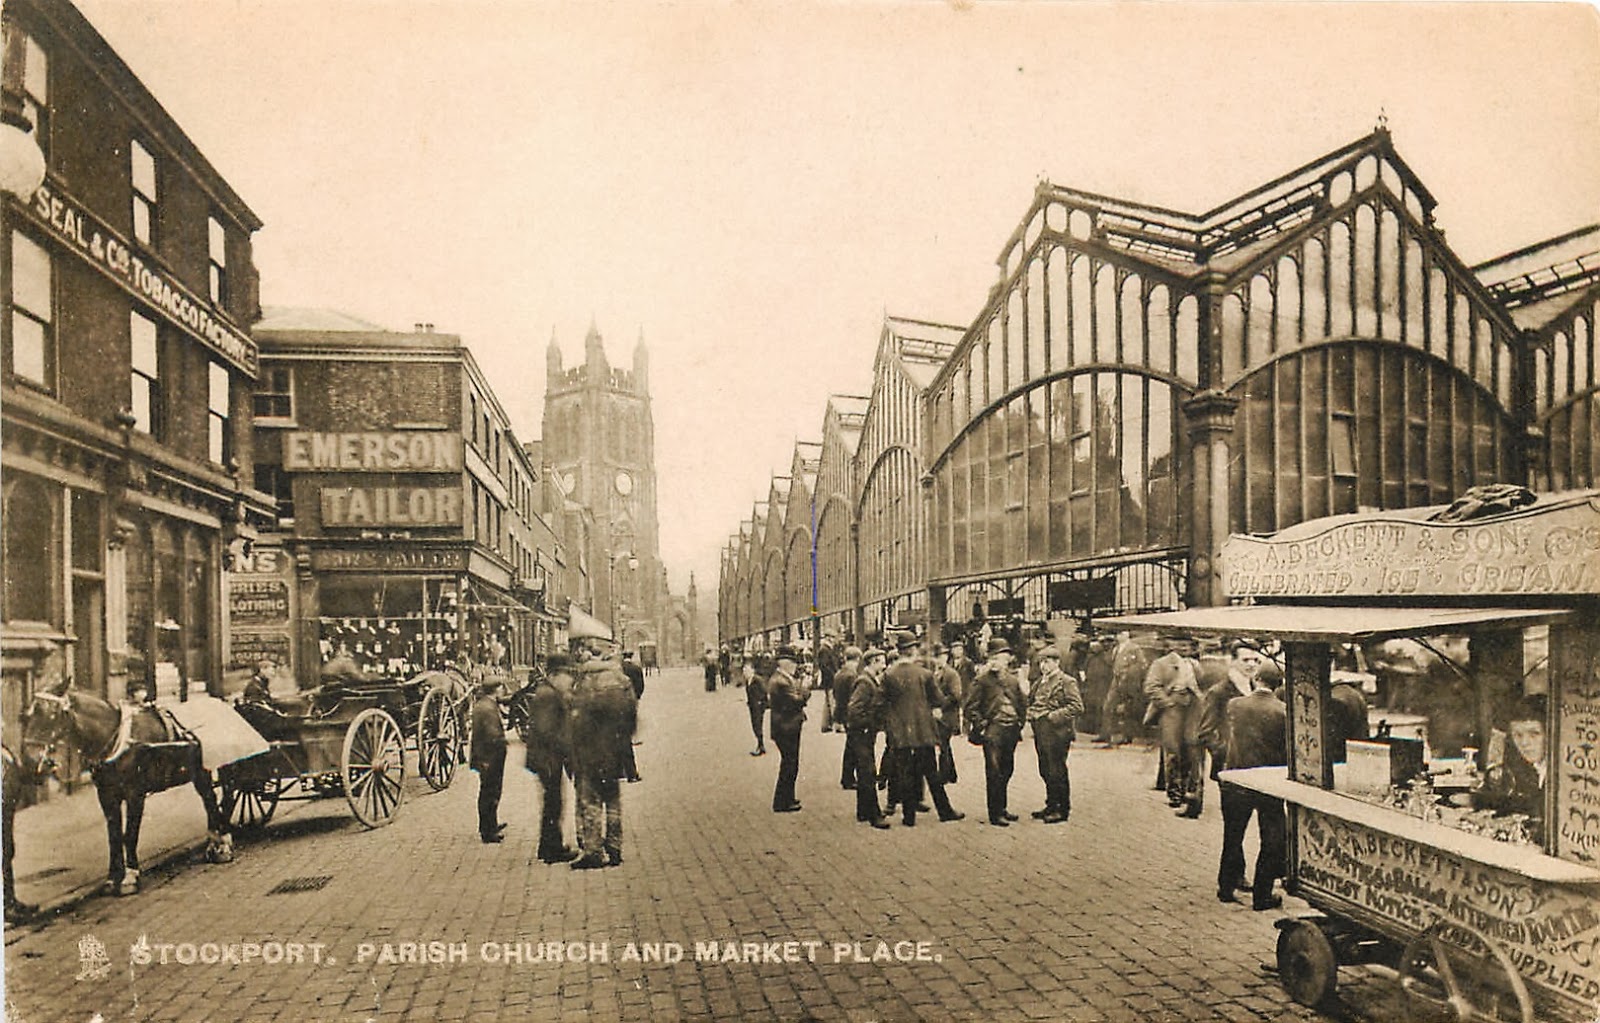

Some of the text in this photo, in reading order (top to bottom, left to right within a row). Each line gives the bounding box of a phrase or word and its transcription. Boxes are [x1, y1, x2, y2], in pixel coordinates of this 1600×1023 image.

[36, 188, 88, 248] SEAL
[90, 232, 104, 260] &
[132, 257, 198, 328] TOBACCO
[289, 432, 457, 468] EMERSON
[324, 487, 458, 521] TAILOR
[1229, 571, 1353, 594] CELEBRATED
[1576, 727, 1598, 742] TO
